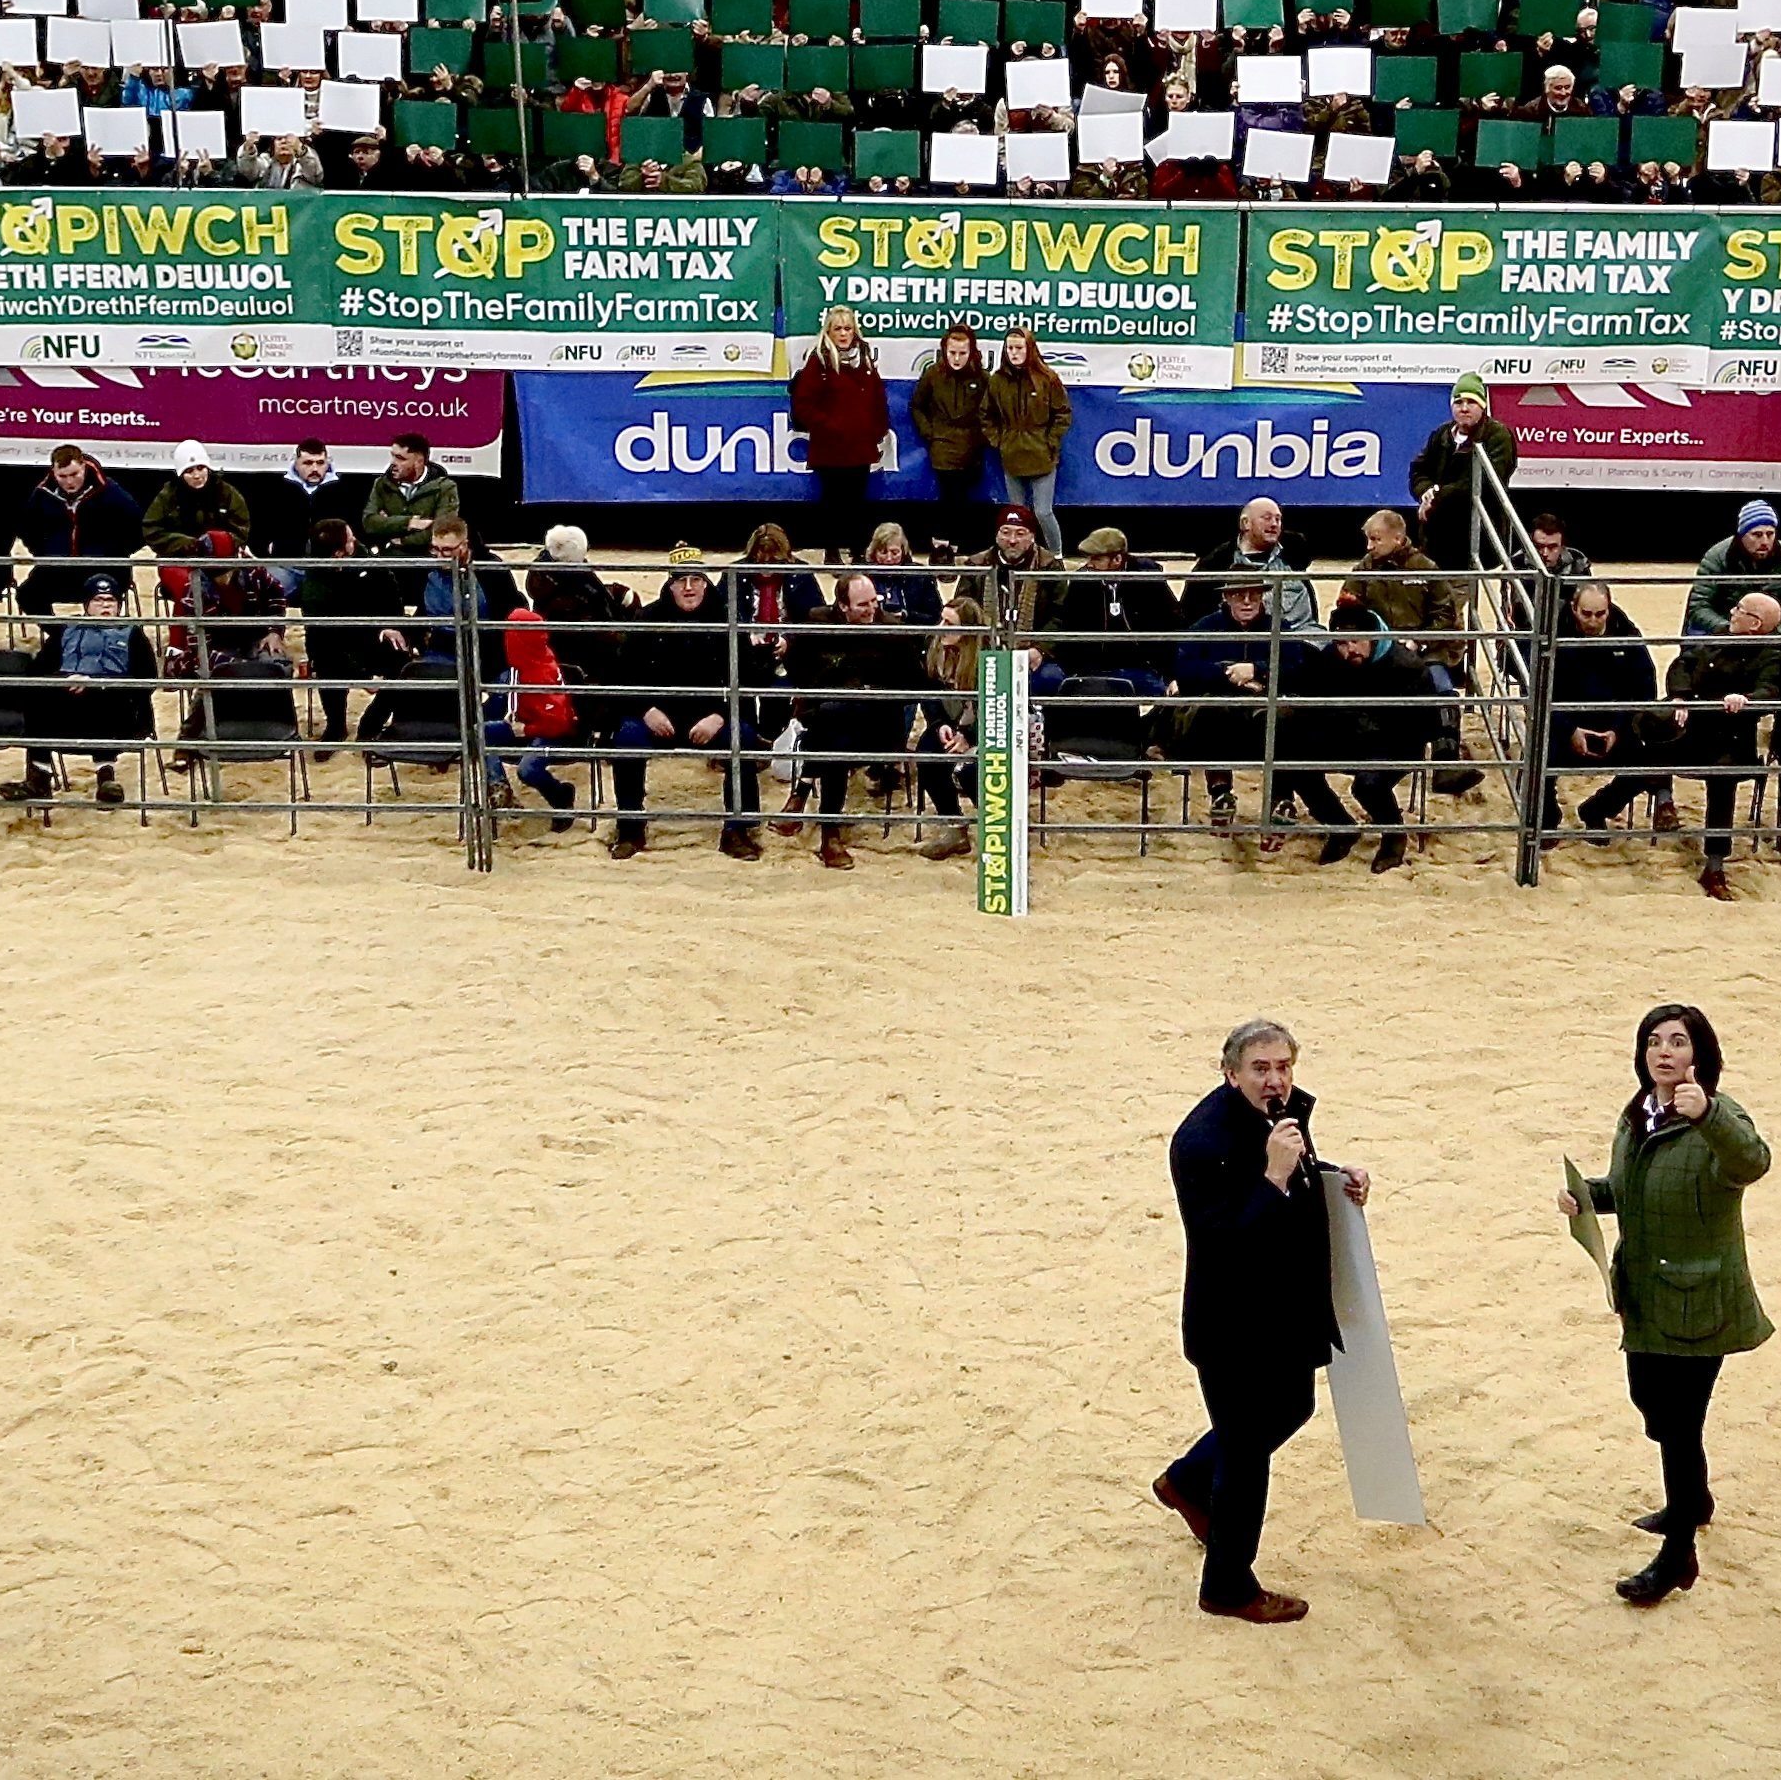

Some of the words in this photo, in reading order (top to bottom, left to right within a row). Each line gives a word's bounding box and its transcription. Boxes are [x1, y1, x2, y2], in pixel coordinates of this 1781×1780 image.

[335, 211, 555, 279] STOP
[562, 216, 631, 246] THE
[635, 217, 759, 248] FAMILY
[818, 213, 1201, 277] STOPIWCH
[1501, 229, 1573, 260] THE
[1576, 230, 1699, 262] FAMILY
[563, 251, 660, 280] FARM
[666, 251, 734, 281] TAX
[1266, 221, 1493, 293] STOP
[53, 264, 150, 290] FFERM
[156, 265, 291, 291] DEULUOL
[1501, 264, 1595, 294] FARM
[1603, 264, 1672, 294] TAX
[339, 287, 759, 328] #StopTheFamilyFarmTax
[818, 275, 838, 303] Y
[847, 276, 946, 305] DRETH
[953, 277, 1051, 307] FFERM
[1058, 280, 1197, 311] DEULUOL
[1722, 288, 1745, 312] Y
[1267, 302, 1691, 342] #StopTheFamilyFarmTax
[42, 334, 100, 358] NFU
[393, 338, 415, 348] your
[417, 338, 450, 350] support
[563, 345, 602, 361] NFU
[630, 345, 656, 356] NFU
[1295, 353, 1316, 362] Show
[1319, 356, 1341, 364] your
[1344, 354, 1379, 364] support
[1382, 354, 1393, 362] at
[1493, 358, 1532, 374] NFU
[1560, 359, 1585, 370] NFU
[1737, 359, 1778, 376] NFU
[31, 407, 74, 425] Your
[78, 408, 161, 427] Experts...
[258, 396, 469, 420] mccartneys.co.uk
[1094, 418, 1382, 480] dunbia
[1515, 426, 1568, 444] We're
[1572, 428, 1616, 445] Your
[1619, 428, 1705, 447] Experts...
[985, 656, 997, 696] FFERM
[985, 698, 997, 738] DRETH
[997, 692, 1008, 749] DEULUOL
[984, 751, 1008, 913] STOPIWCH
